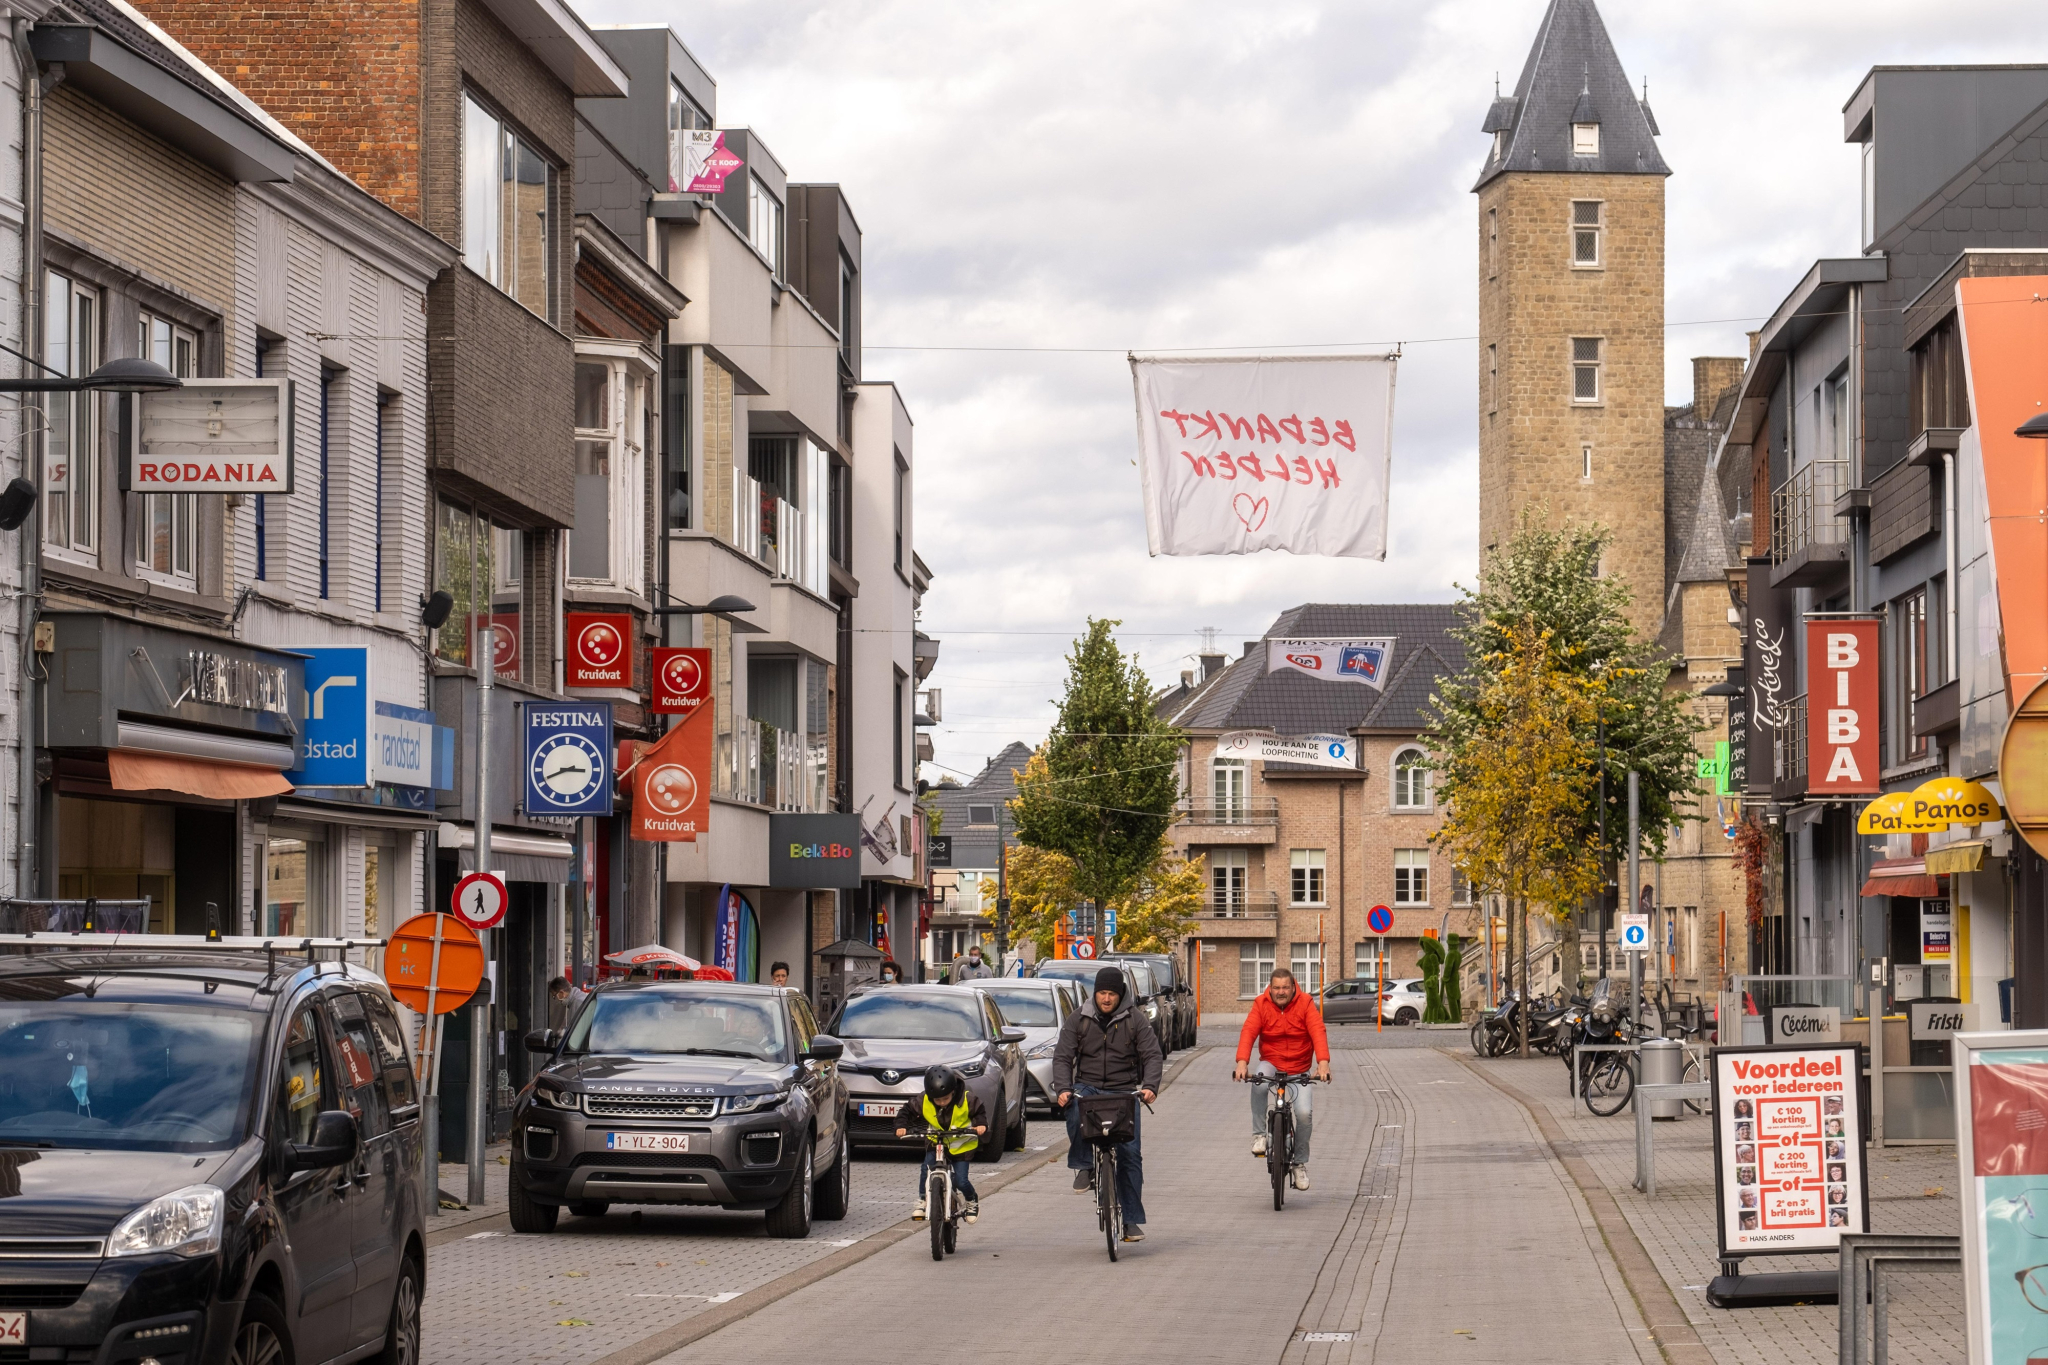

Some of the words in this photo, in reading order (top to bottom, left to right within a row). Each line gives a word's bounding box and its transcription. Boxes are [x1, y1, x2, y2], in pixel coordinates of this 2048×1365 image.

[692, 132, 712, 142] M3
[139, 462, 277, 483] RODANIA
[578, 669, 621, 680] Kruidvat
[662, 697, 701, 706] Kruidvat
[1825, 633, 1863, 782] BIBA
[531, 712, 604, 727] FESTINA
[1280, 740, 1289, 748] JE
[1290, 741, 1307, 749] AAN
[1312, 736, 1346, 744] BORNEM
[382, 724, 421, 770] randstad
[1261, 748, 1319, 760] LOOPRICHTING
[1914, 800, 1990, 819] Panos
[644, 818, 696, 831] Kruidvat
[790, 843, 852, 858] Bel&Bo
[1930, 902, 1943, 913] TE
[1781, 1014, 1832, 1037] Cécémel
[1927, 1013, 1964, 1030] Fristi
[1732, 1055, 1842, 1079] Voordeel
[1733, 1084, 1769, 1095] voor
[1772, 1079, 1843, 1094] iedereen
[1777, 1107, 1784, 1115] €
[1785, 1106, 1803, 1115] 100
[1772, 1116, 1806, 1125] korting
[1781, 1131, 1800, 1147] of
[1779, 1153, 1786, 1161] €
[1787, 1152, 1805, 1160] 200
[1774, 1161, 1808, 1170] korting
[1782, 1176, 1801, 1191] of
[1771, 1209, 1787, 1217] bril
[1788, 1208, 1815, 1218] gratis
